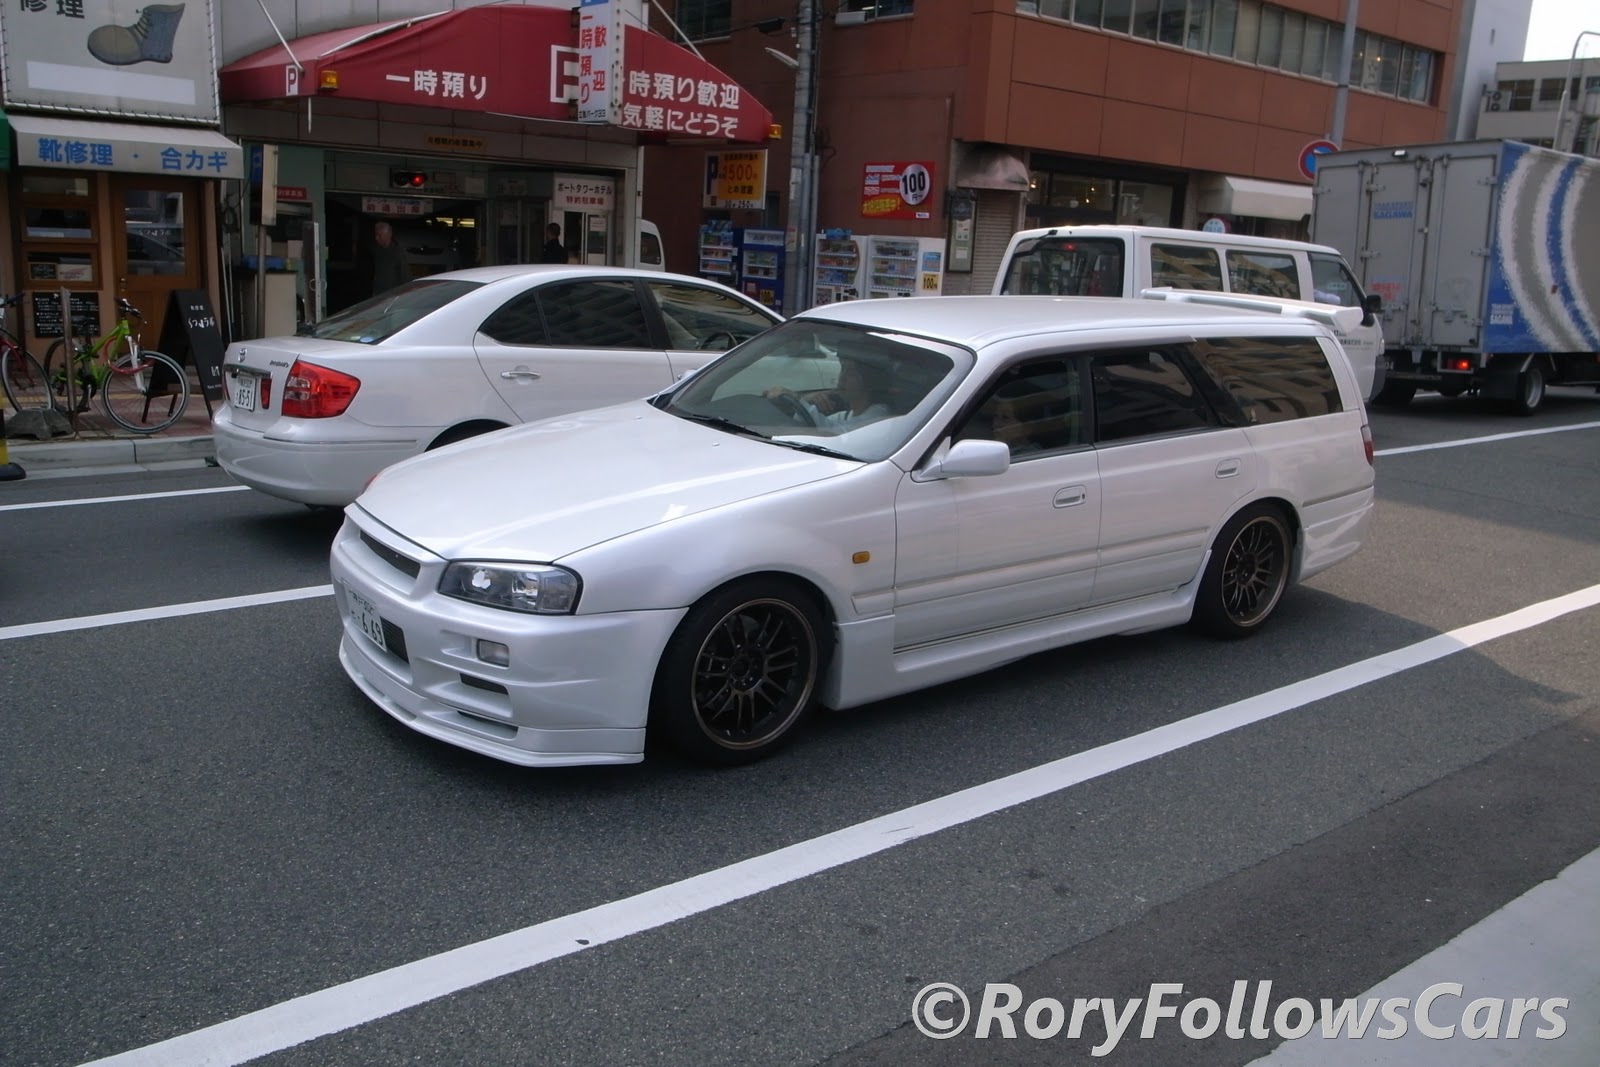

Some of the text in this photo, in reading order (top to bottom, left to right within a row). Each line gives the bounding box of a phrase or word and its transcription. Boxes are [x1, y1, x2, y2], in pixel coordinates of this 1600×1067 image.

[581, 15, 593, 104] 一時預り
[593, 26, 607, 92] 歓迎
[287, 67, 297, 93] P
[386, 69, 488, 101] 一時預り
[623, 70, 740, 111] 時預り歓迎
[623, 103, 739, 139] 気軽にどうぞ
[38, 137, 229, 173] 靴修理 合カギ
[557, 183, 613, 195] ポートタワーホテル
[706, 155, 719, 195] P
[902, 171, 926, 195] 100
[1373, 210, 1413, 219] SAGAWA
